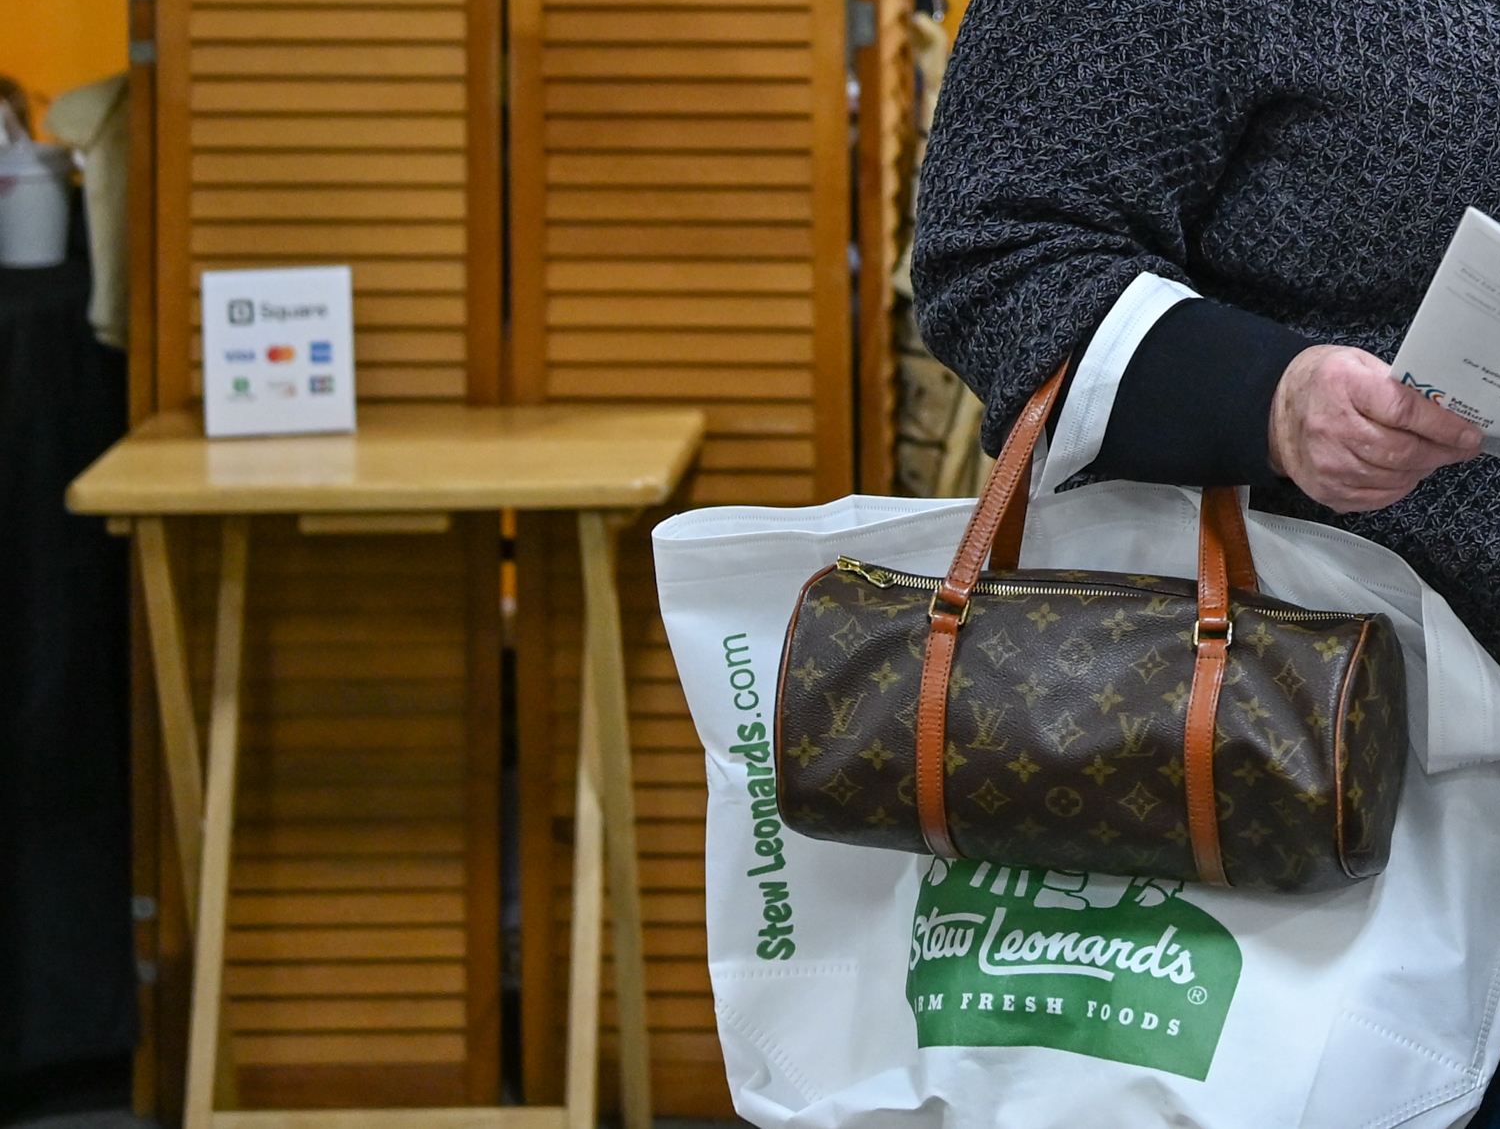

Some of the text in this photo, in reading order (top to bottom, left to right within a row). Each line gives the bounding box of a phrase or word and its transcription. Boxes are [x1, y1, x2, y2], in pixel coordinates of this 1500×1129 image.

[260, 301, 328, 323] Square
[909, 906, 987, 971] Stew
[978, 906, 1196, 985] Leonard's
[960, 992, 1064, 1014] FRESH
[1086, 1000, 1182, 1036] FOODS
